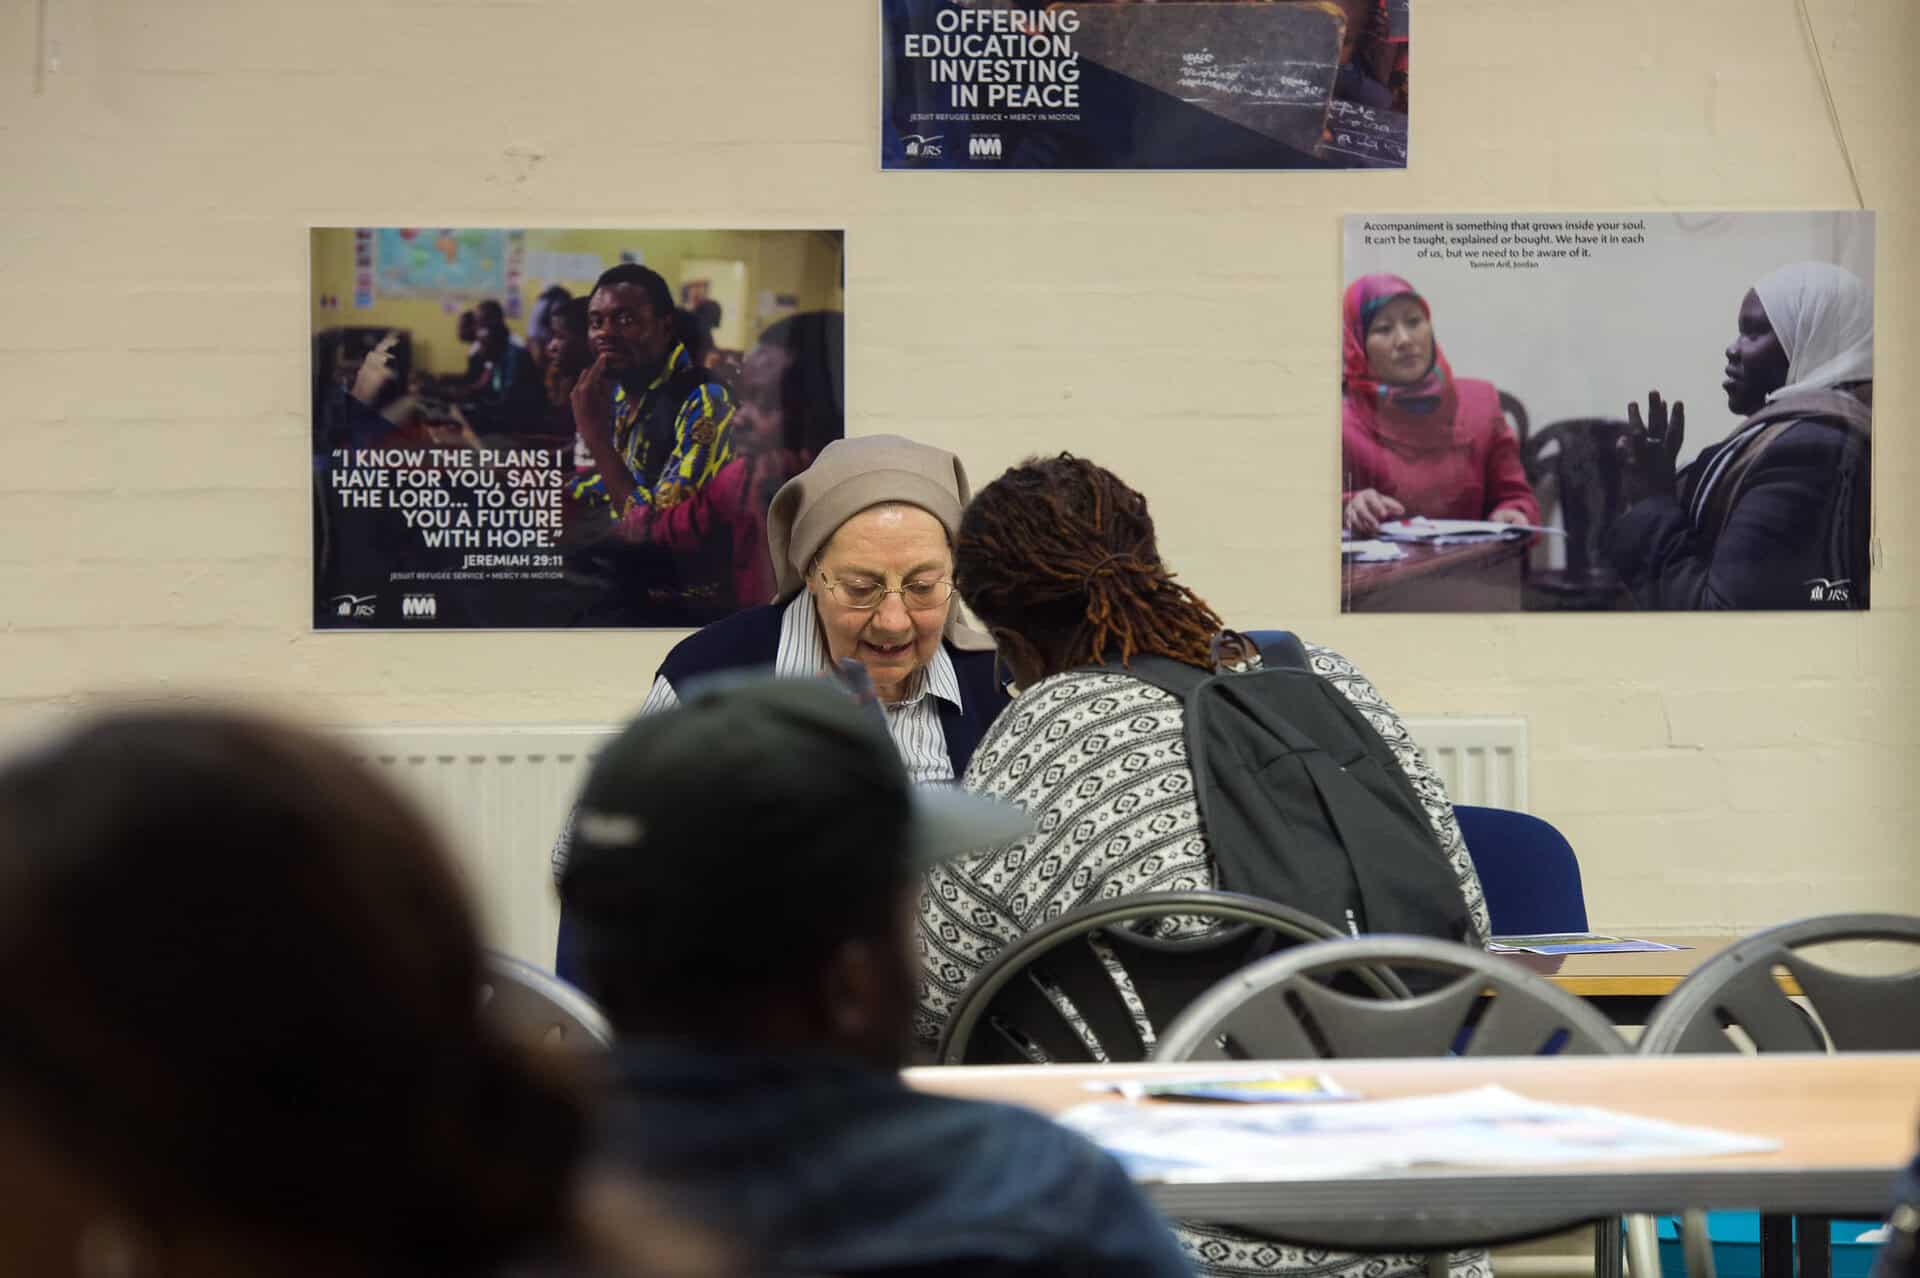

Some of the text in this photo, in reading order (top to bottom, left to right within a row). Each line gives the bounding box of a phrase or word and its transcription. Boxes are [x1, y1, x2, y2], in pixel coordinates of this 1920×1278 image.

[936, 9, 1081, 33] OFFERING
[904, 34, 1080, 62] EDUCATION,
[931, 59, 1081, 83] INVESTING
[951, 84, 1080, 108] IN PEACE
[909, 114, 933, 122] JESUIT
[1364, 220, 1646, 233] Accompaniment is something that grows inside your soul.
[1364, 234, 1645, 246] It can't be taught, explained or bought. We have it in each
[1417, 248, 1428, 257] of
[1430, 250, 1444, 259] us,
[1445, 248, 1463, 257] but
[1481, 248, 1507, 257] need
[1509, 249, 1519, 257] to
[1521, 248, 1535, 257] be
[1569, 247, 1580, 257] of
[1581, 248, 1592, 257] it.
[355, 449, 425, 468] KNOW
[429, 449, 473, 468] THE
[479, 449, 550, 468] PLANS
[556, 449, 562, 468] I
[332, 469, 562, 490] HAVE FOR YOU, SAYS
[338, 489, 562, 508] THE LORD... TO GIVE
[402, 509, 562, 528] YOU A FUTURE
[422, 529, 480, 548] WITH
[462, 555, 562, 569] JEREMIAH 29:11
[390, 572, 414, 580] JESUIT
